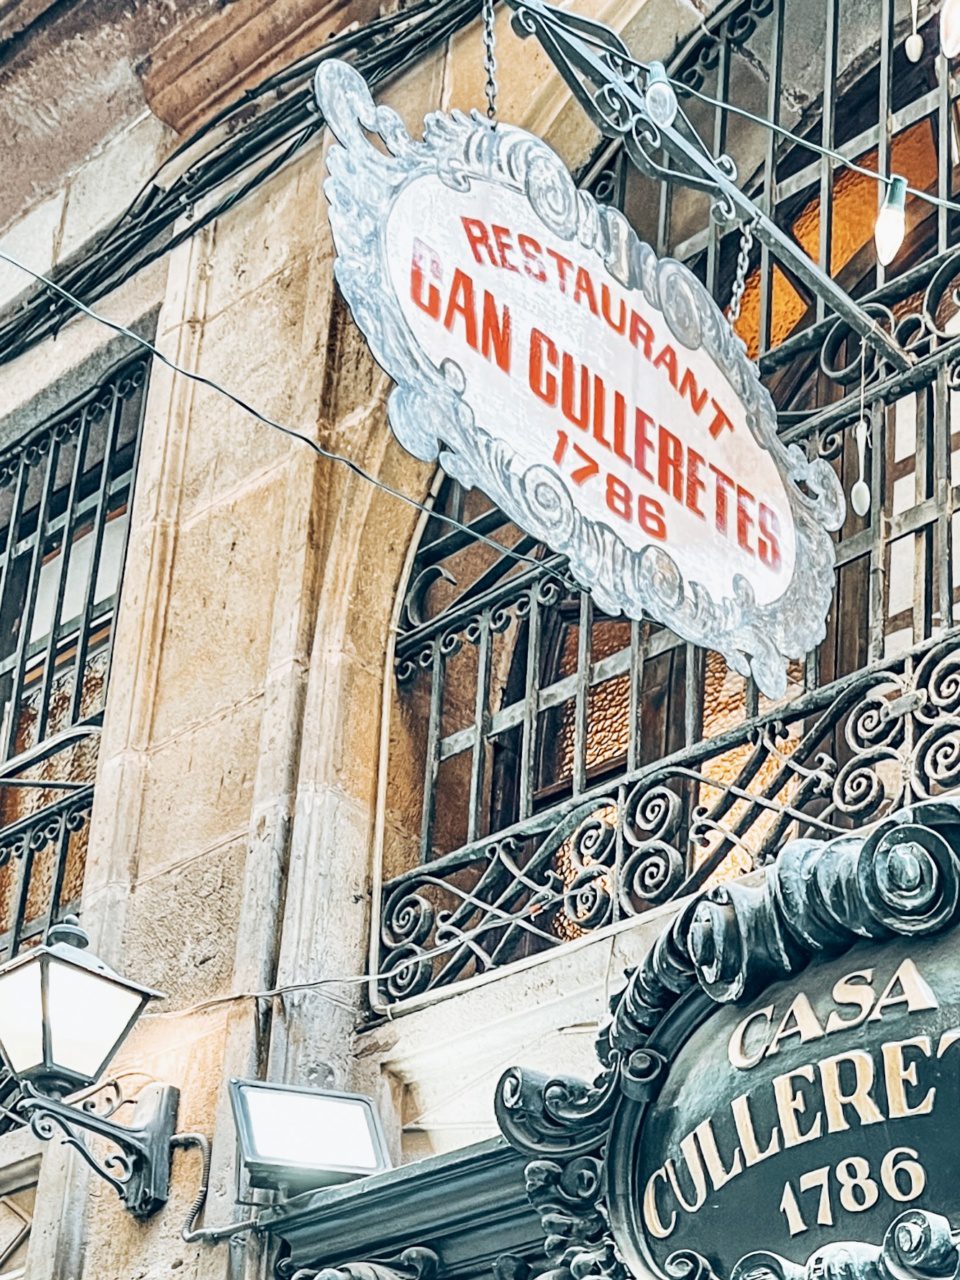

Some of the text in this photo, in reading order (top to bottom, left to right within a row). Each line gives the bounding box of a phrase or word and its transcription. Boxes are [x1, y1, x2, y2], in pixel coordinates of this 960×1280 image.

[460, 215, 735, 440] RESTAURANT
[528, 327, 783, 574] CULLERETES
[552, 429, 668, 541] 1786
[727, 957, 938, 1070] CASA
[779, 1146, 927, 1238] 1786
